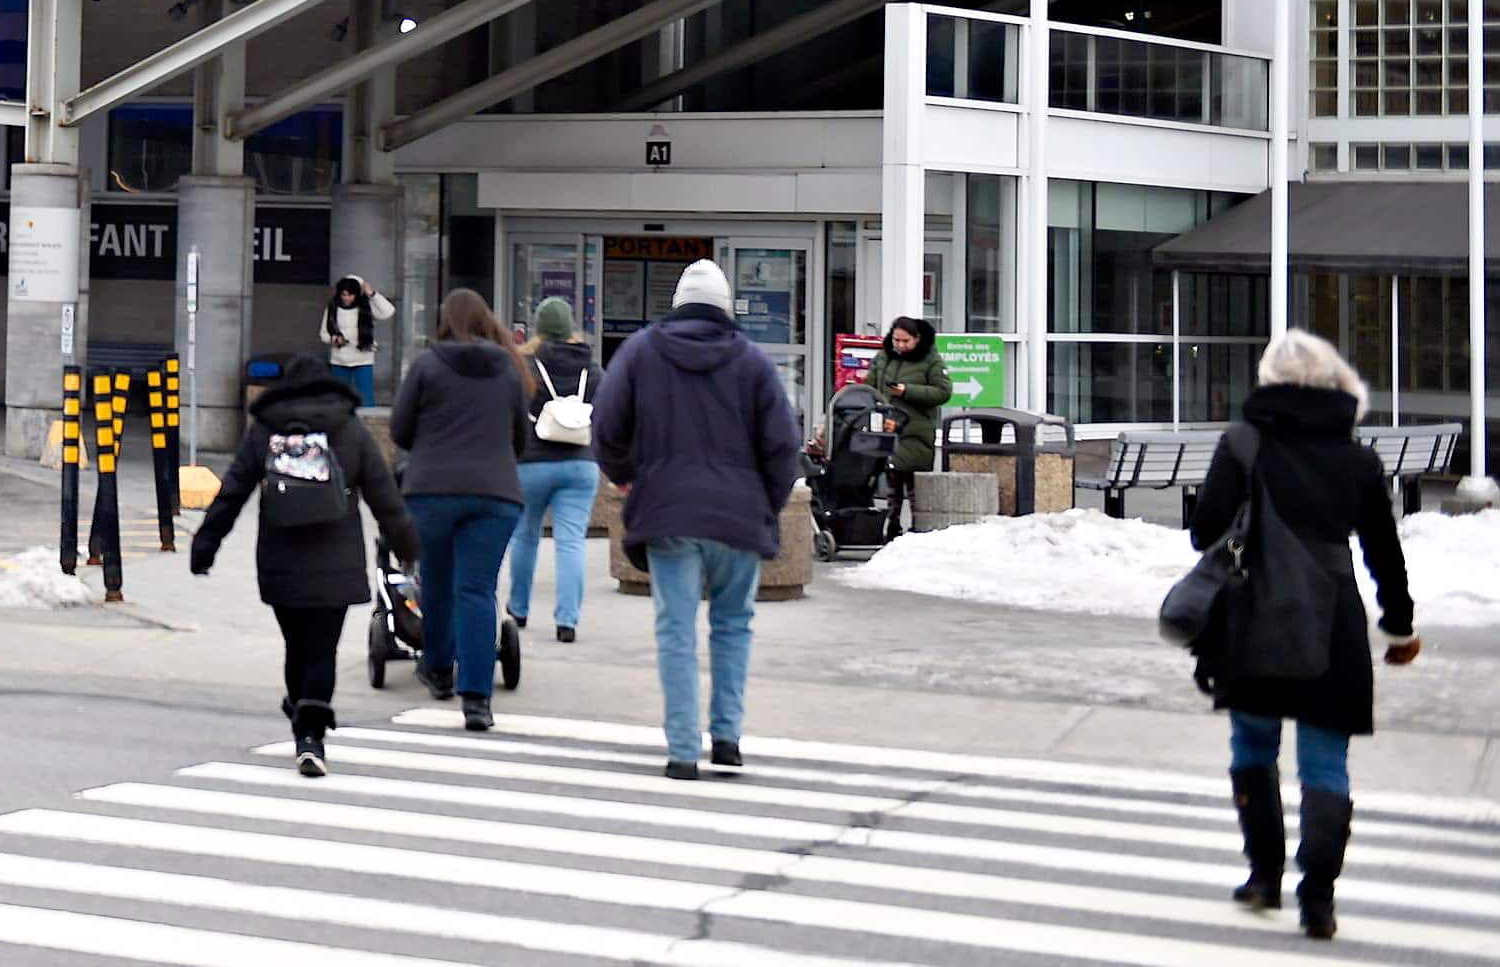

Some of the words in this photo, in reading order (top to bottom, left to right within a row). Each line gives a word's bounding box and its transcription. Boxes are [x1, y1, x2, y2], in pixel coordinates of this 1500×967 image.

[650, 145, 668, 161] A1
[89, 224, 170, 259] FANT
[604, 237, 716, 256] PORTANT
